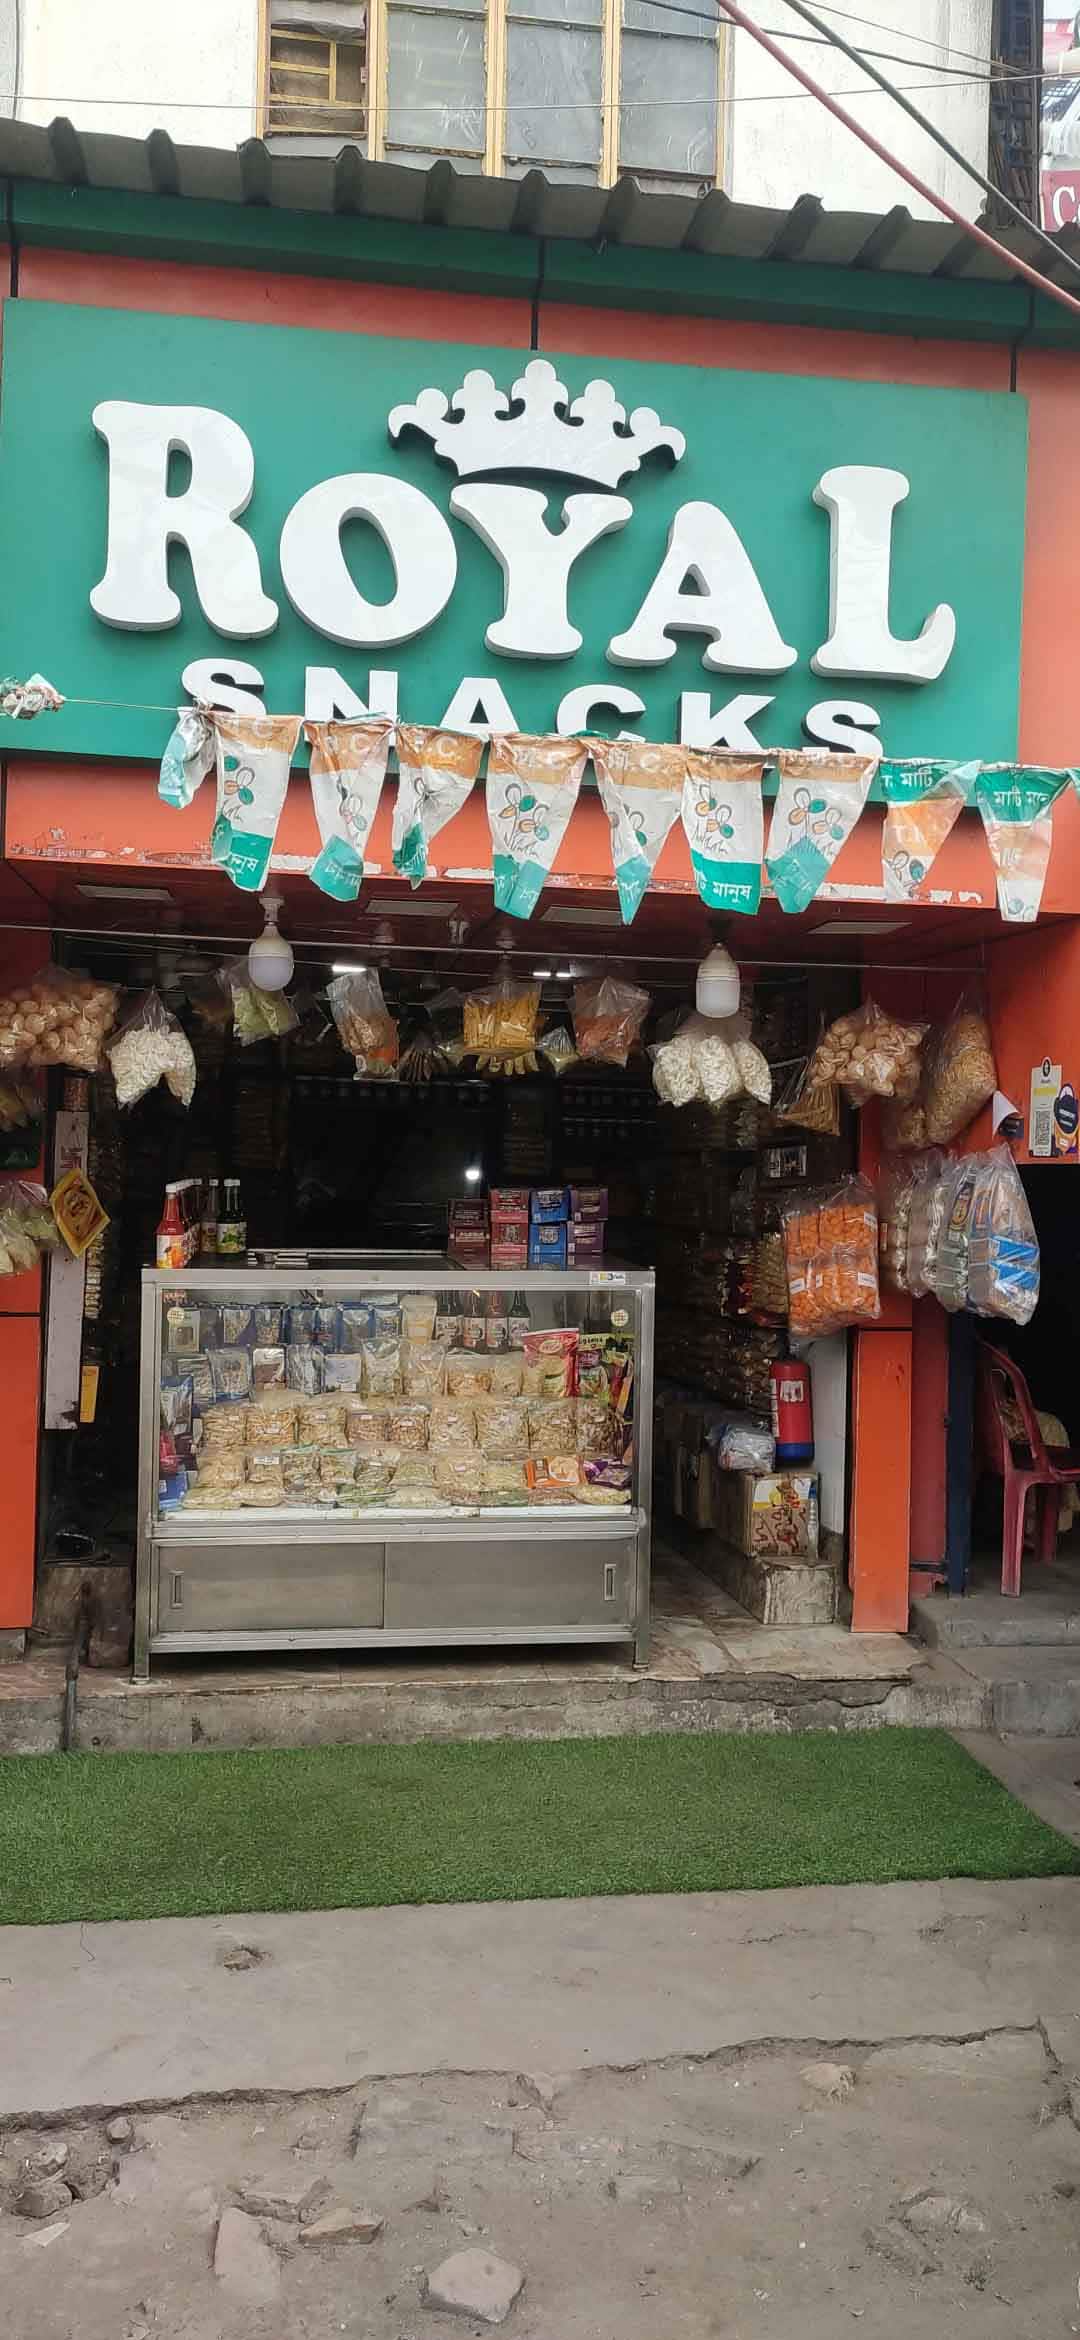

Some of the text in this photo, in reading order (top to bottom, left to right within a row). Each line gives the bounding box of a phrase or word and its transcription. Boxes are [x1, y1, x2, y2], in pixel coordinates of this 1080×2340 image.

[90, 400, 957, 684] ROYAL
[180, 658, 883, 760] SNACKS
[712, 881, 753, 904] মানুষ
